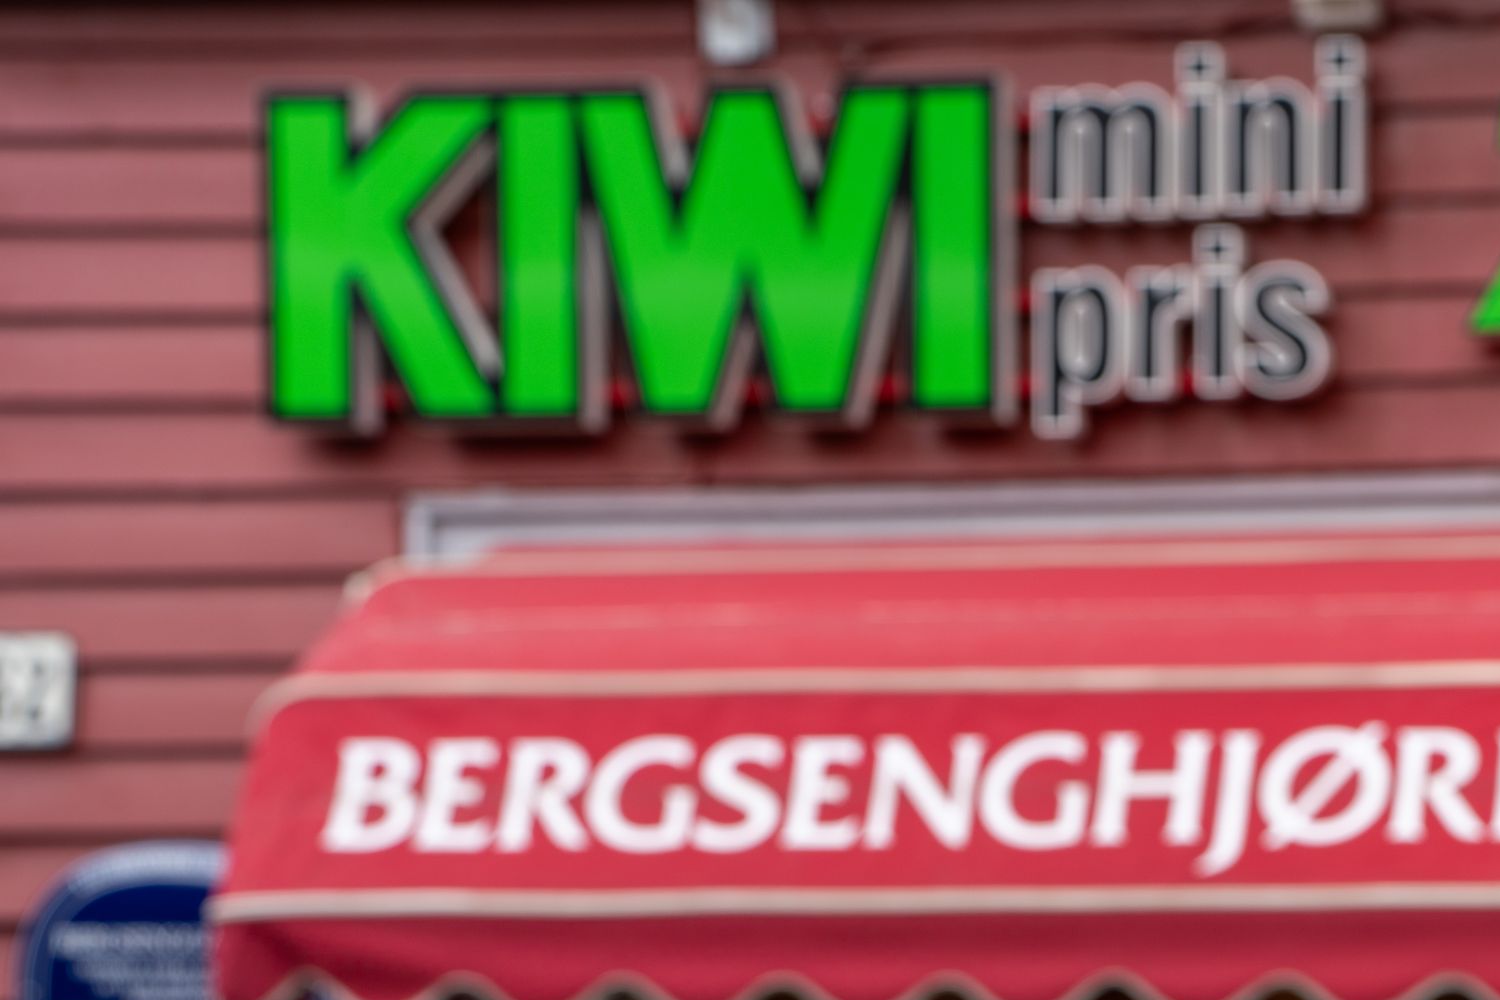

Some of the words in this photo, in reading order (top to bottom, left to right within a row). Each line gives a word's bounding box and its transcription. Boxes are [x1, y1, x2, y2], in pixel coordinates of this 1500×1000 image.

[1030, 33, 1367, 222] mini
[264, 82, 1008, 428] KIWI
[1031, 224, 1332, 440] pris
